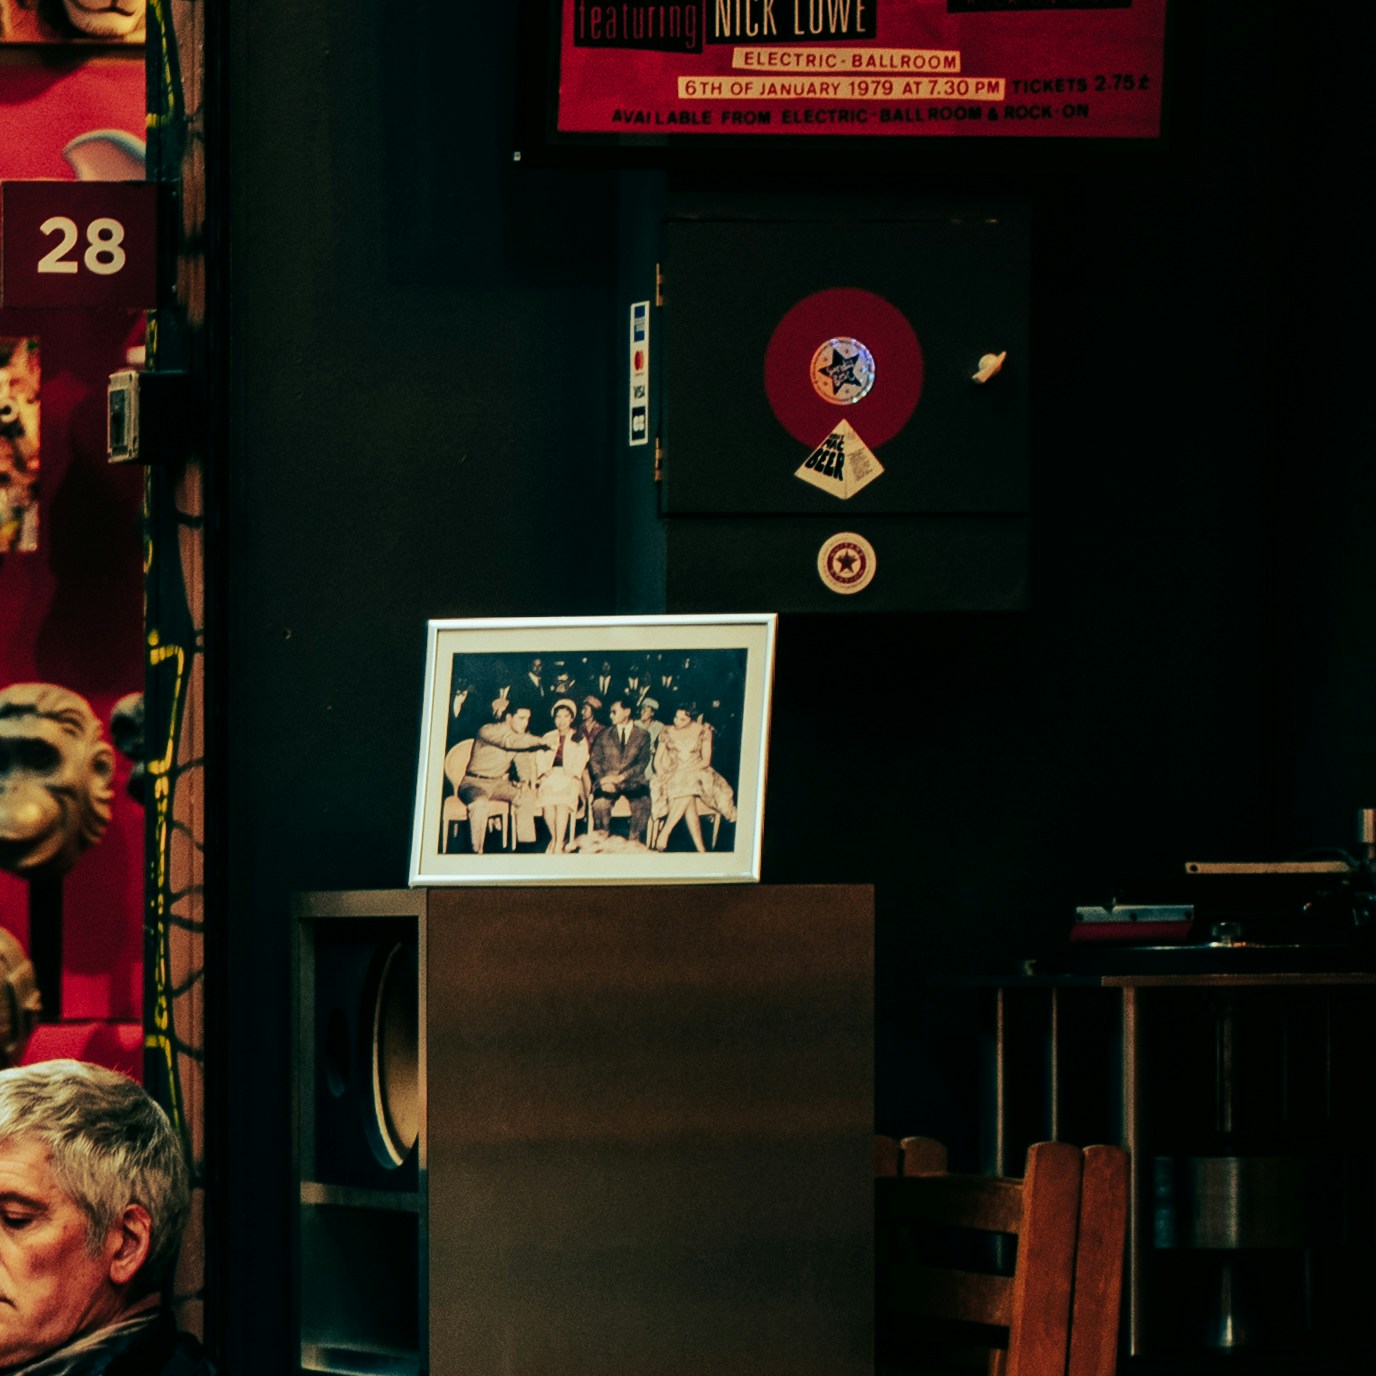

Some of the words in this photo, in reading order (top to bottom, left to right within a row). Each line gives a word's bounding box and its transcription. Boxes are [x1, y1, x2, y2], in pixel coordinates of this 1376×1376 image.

[577, 0, 698, 49] featuring
[714, 0, 778, 38] NICK
[793, 0, 868, 36] LOWE
[684, 80, 722, 96] 6TH
[730, 81, 753, 96] OF
[760, 81, 840, 96] JANUARY
[848, 80, 893, 96] 1979
[902, 80, 922, 95] AT
[928, 79, 969, 96] 7.30
[975, 81, 1000, 95] PM
[1011, 78, 1088, 94] TICKETS
[612, 108, 712, 125] AVAILABLE
[721, 109, 771, 124] FROM
[987, 107, 998, 121] &
[37, 216, 126, 275] 28
[804, 448, 846, 482] BEER
